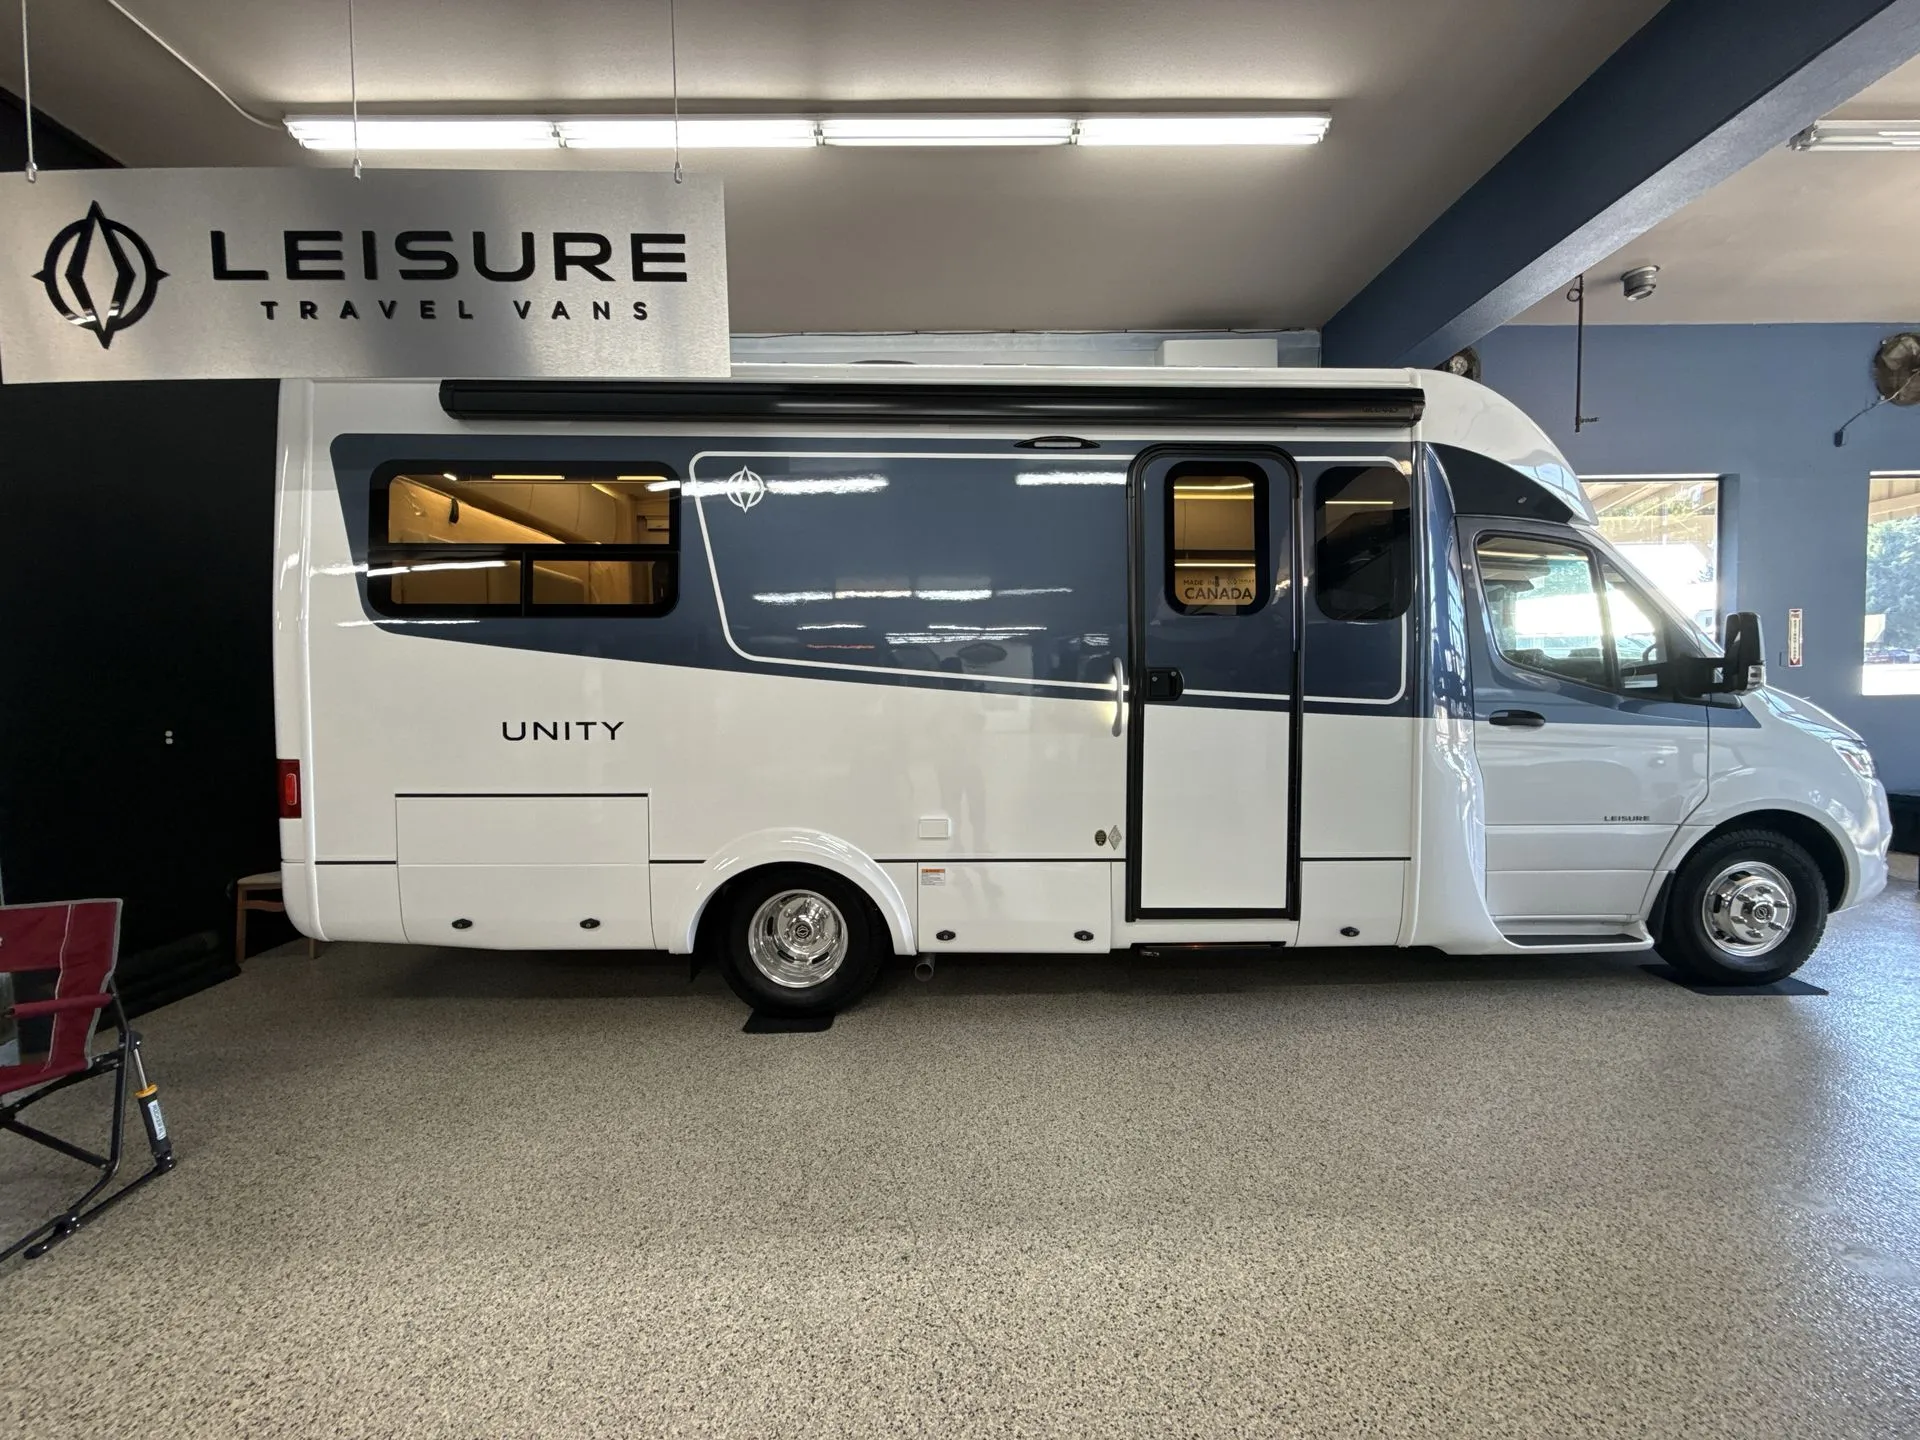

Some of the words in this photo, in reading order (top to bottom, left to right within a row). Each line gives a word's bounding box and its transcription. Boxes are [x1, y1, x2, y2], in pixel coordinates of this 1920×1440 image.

[210, 230, 687, 282] LEISURE
[261, 300, 474, 320] TRAVEL
[513, 300, 650, 320] VANS
[1184, 587, 1253, 600] CANADA
[502, 722, 624, 741] UNITY
